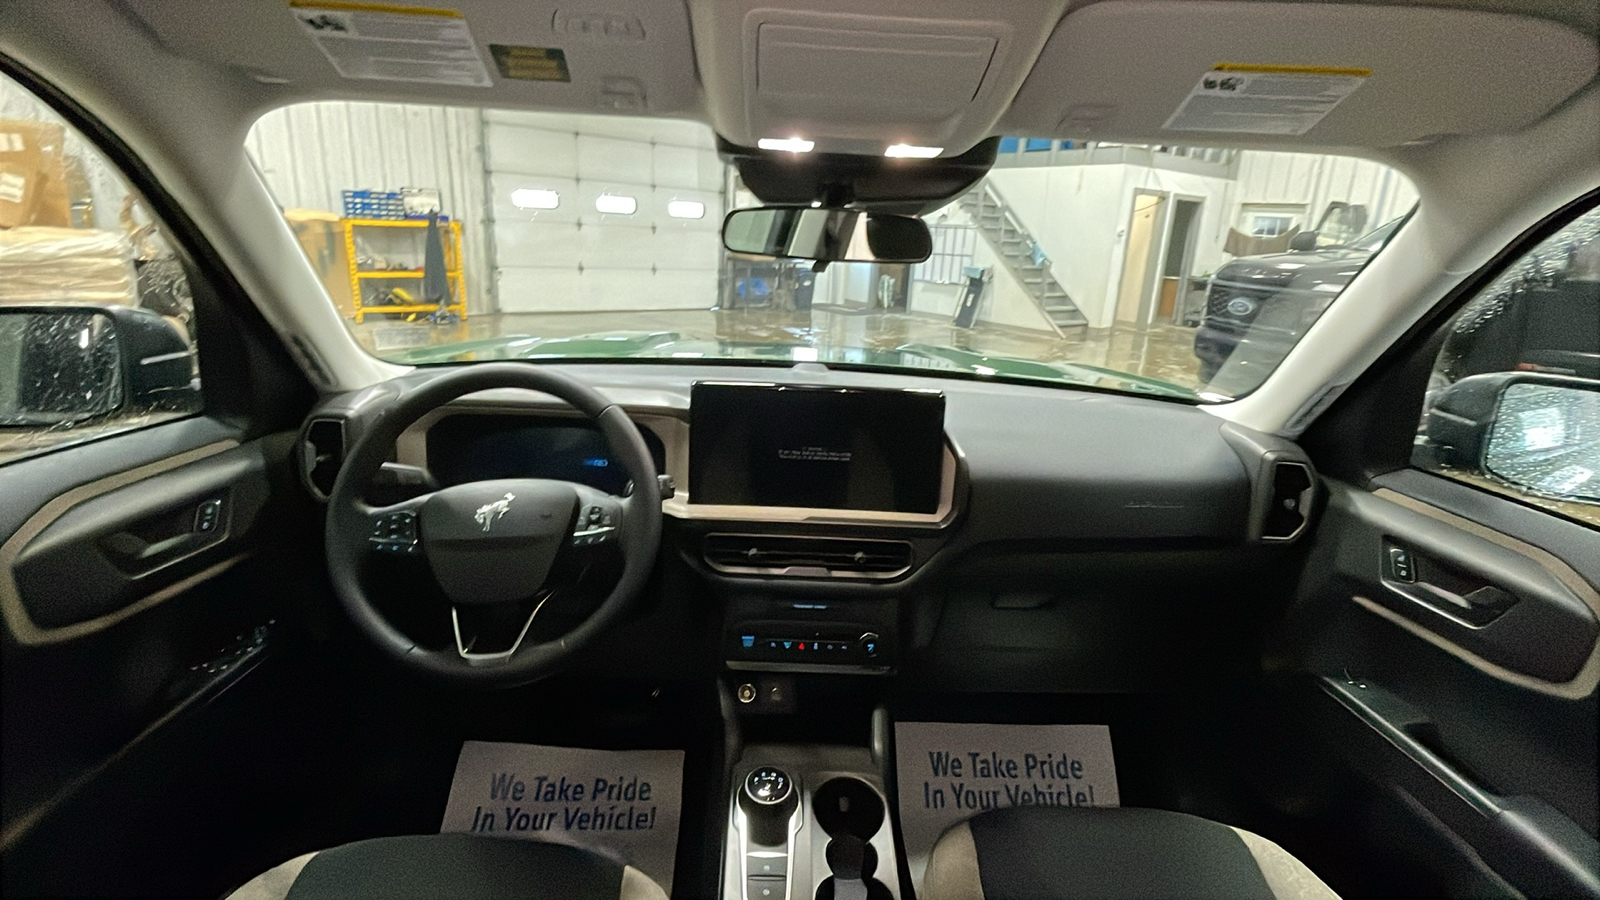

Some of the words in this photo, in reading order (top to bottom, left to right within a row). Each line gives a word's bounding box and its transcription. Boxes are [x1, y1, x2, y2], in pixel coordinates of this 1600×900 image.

[929, 751, 962, 777] We
[968, 752, 1018, 779] Take
[1024, 753, 1083, 780] Pride
[490, 772, 525, 801] We
[534, 776, 585, 802] Take
[591, 776, 652, 802] Pride
[924, 782, 946, 809] In
[951, 783, 1001, 810] Your
[471, 806, 496, 832] In
[505, 807, 558, 832] Your
[563, 806, 657, 831] Vehicle!
